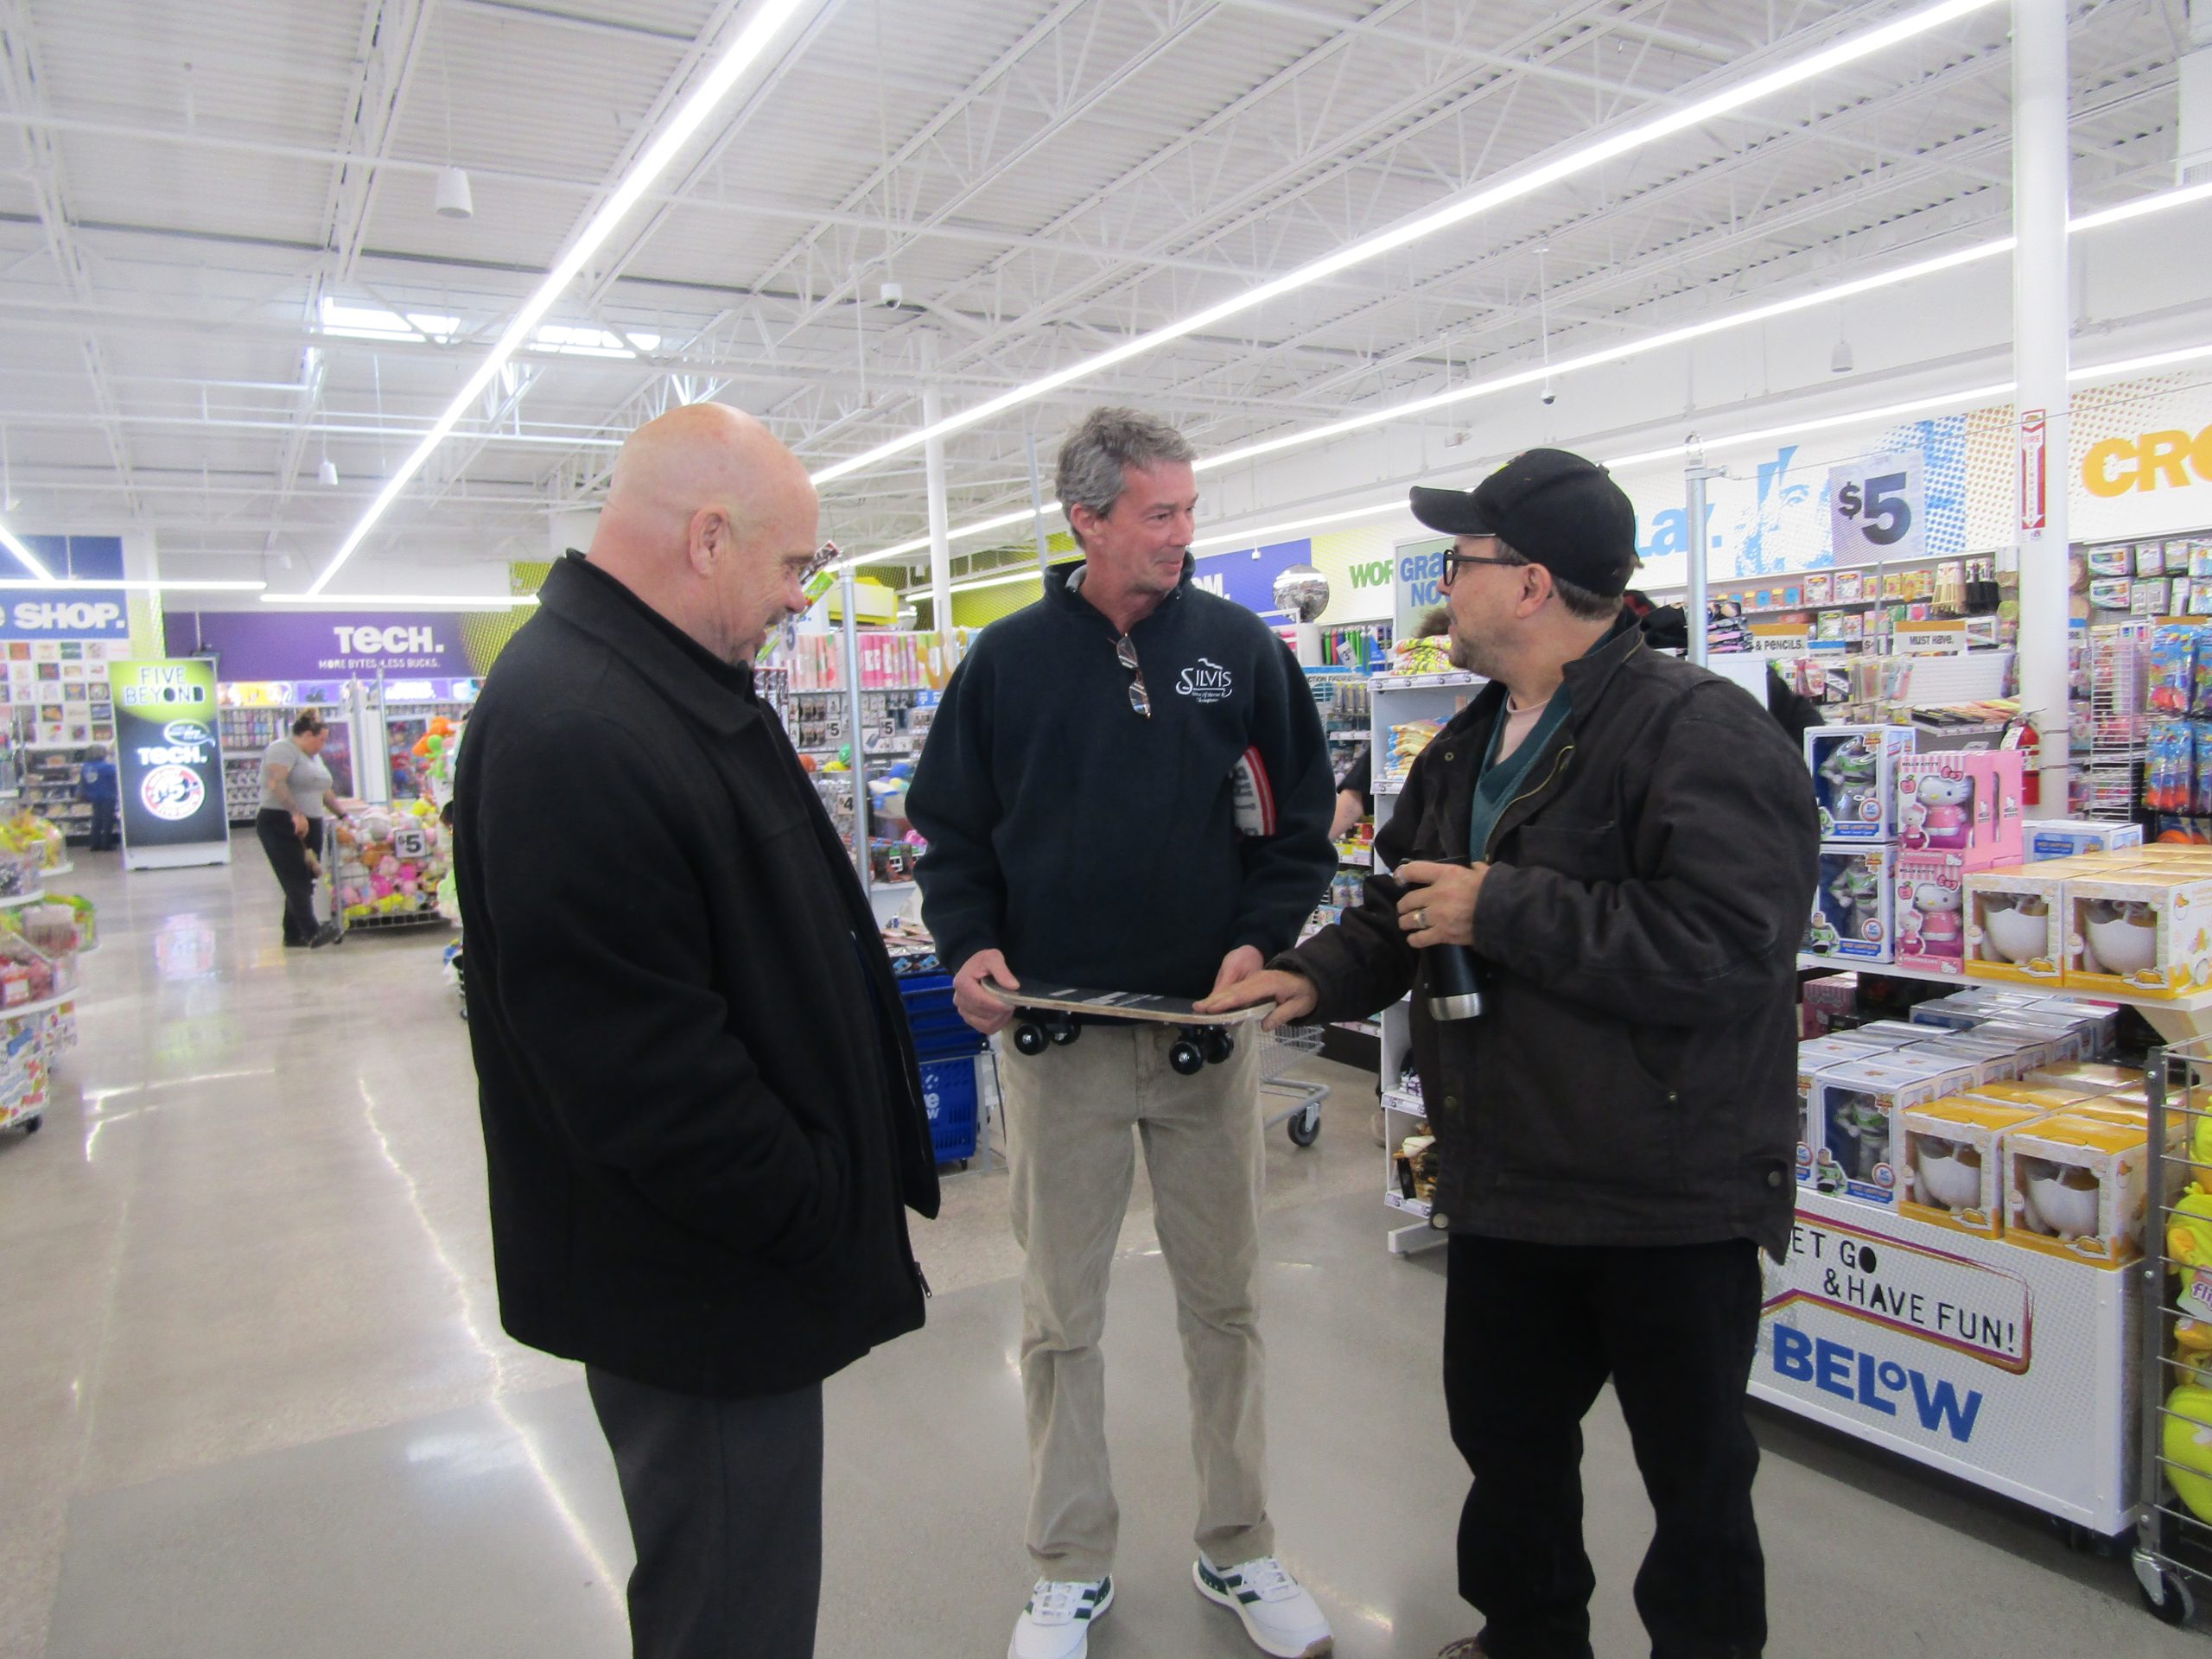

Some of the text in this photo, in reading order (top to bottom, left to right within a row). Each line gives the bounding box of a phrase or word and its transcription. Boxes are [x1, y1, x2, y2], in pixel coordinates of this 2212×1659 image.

[1839, 472, 1910, 545] $5
[14, 602, 125, 629] SHOP.
[141, 667, 186, 685] FIVE
[1176, 667, 1231, 695] SILVIS
[124, 685, 205, 705] BEYOND
[1792, 1226, 1877, 1274] ET GO
[1823, 1268, 2014, 1352] & HAVE FUN!
